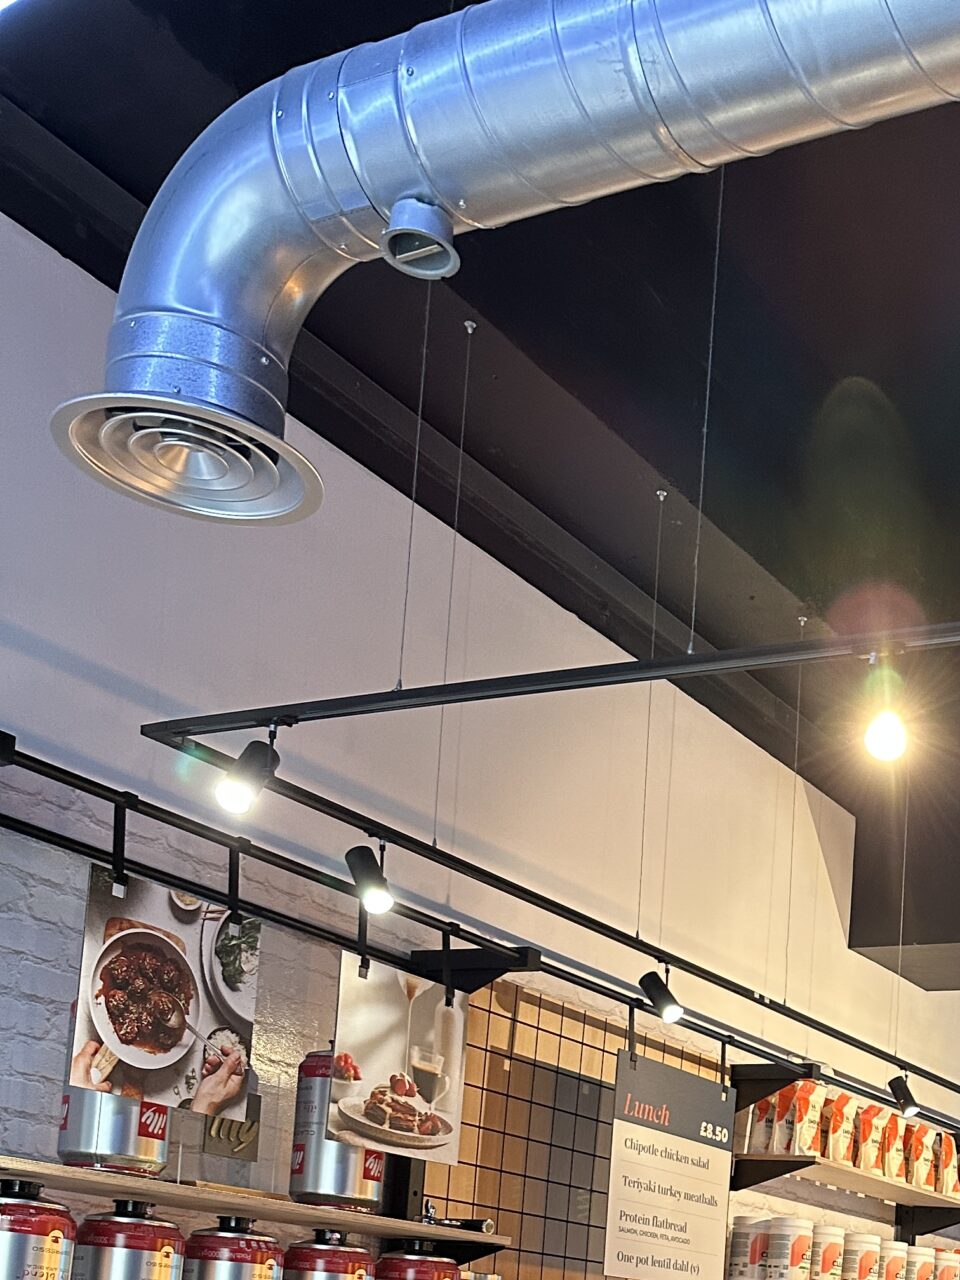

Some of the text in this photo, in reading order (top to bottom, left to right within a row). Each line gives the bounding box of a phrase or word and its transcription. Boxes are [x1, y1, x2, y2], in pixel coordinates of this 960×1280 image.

[141, 1106, 168, 1135] illy
[623, 1093, 670, 1127] Lunch
[700, 1120, 729, 1144] £8.50
[365, 1153, 385, 1178] illy
[624, 1137, 710, 1170] Chipotle chicken salad
[622, 1175, 718, 1207] Teriyaki turkey meatballs
[619, 1210, 688, 1233] Protein flatbread
[616, 1251, 700, 1276] One pot lentil dahl (v)
